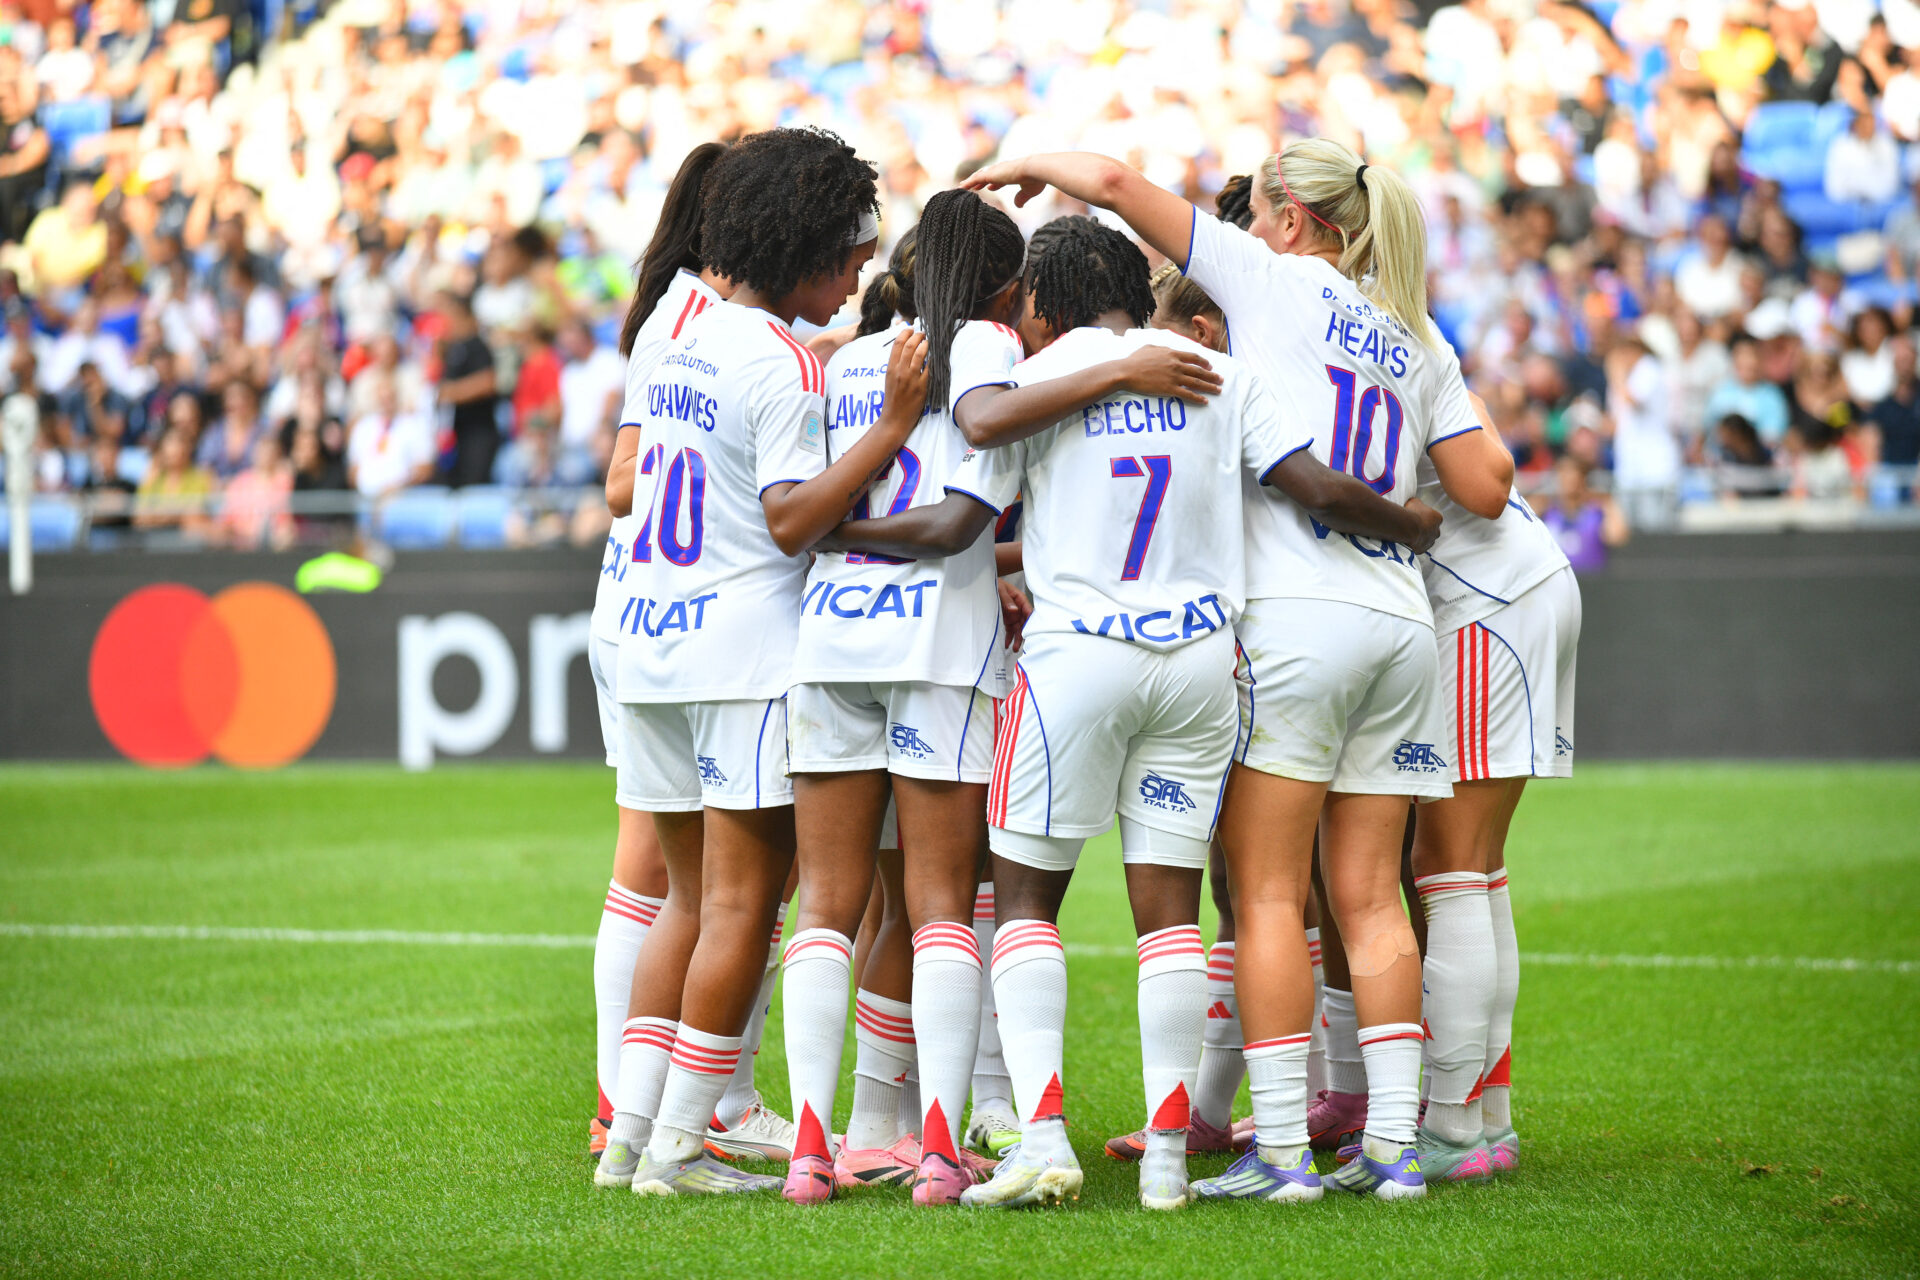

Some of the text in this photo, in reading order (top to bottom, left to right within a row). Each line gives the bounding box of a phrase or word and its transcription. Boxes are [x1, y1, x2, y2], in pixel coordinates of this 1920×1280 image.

[1325, 311, 1409, 378] HEAPS
[1082, 396, 1187, 437] BECHO
[1325, 363, 1404, 496] 10
[632, 443, 707, 567] 20
[1110, 455, 1172, 581] 7
[801, 580, 938, 619] VICAT
[1071, 594, 1227, 642] VICAT
[1422, 766, 1439, 774] T.P.
[1143, 797, 1188, 814] STAL T.P.
